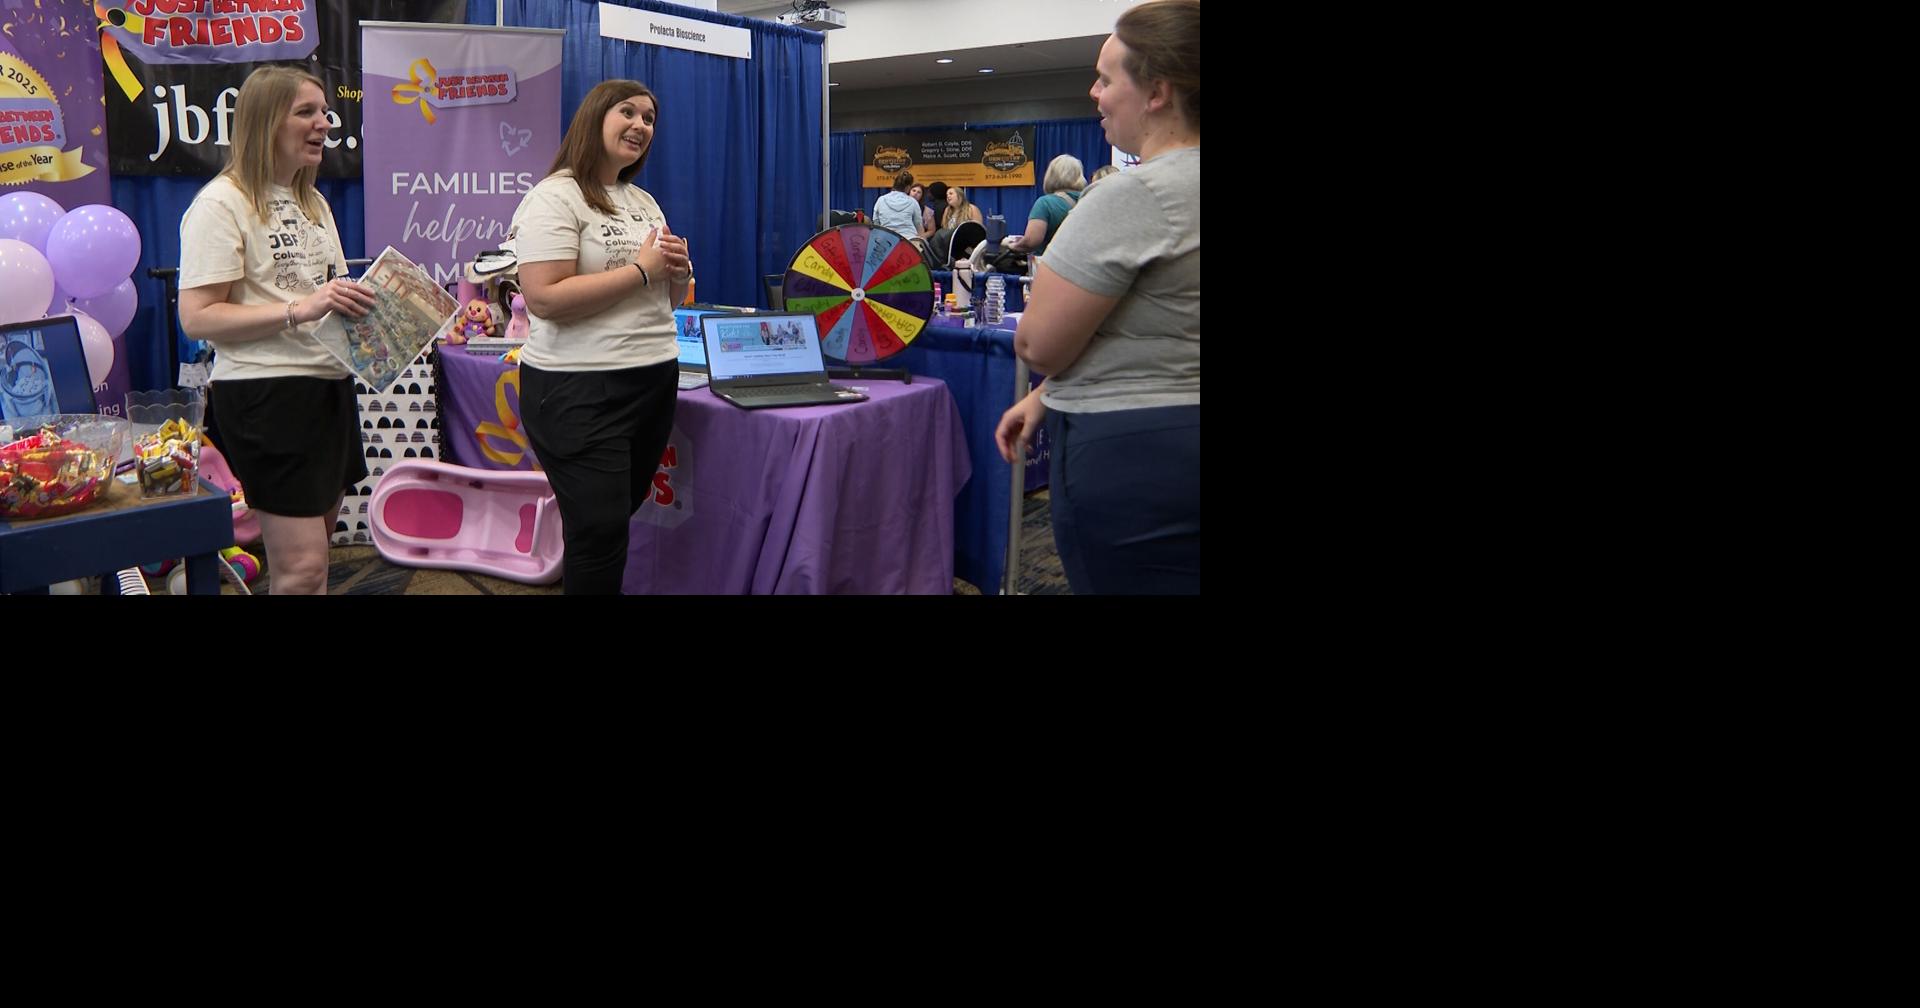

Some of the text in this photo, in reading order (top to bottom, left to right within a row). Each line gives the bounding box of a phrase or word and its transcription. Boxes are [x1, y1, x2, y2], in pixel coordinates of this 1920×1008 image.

[142, 15, 305, 47] FRIENDS
[649, 22, 706, 42] Prolacta Bioscience
[7, 67, 38, 95] 2025
[337, 85, 363, 102] Shop
[438, 83, 509, 101] FRIENDS
[30, 154, 53, 165] Year
[392, 172, 534, 195] FAMILIES
[803, 255, 834, 283] Candy
